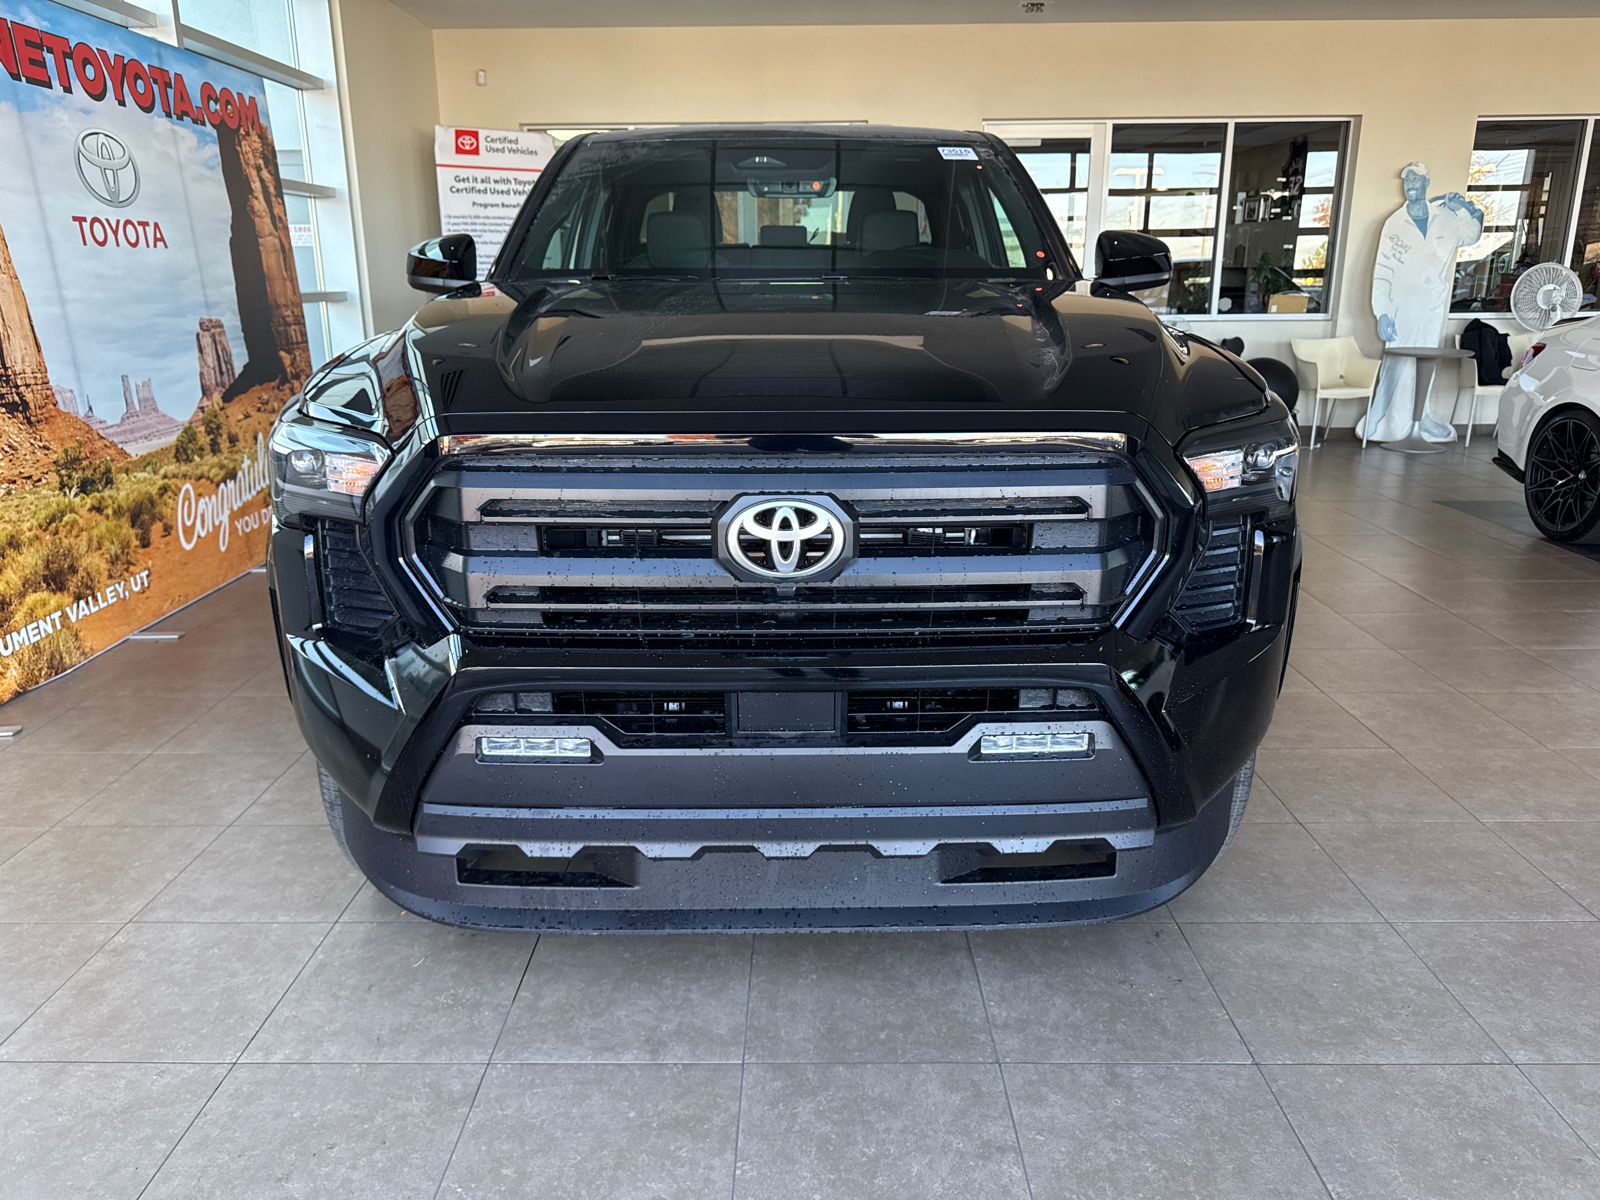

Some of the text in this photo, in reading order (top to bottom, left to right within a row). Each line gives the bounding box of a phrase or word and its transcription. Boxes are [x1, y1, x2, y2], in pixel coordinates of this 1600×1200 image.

[484, 135, 519, 145] Certified
[485, 145, 538, 156] Used Vehicles
[454, 175, 471, 184] Get
[472, 175, 479, 184] it
[480, 176, 492, 185] all
[493, 177, 512, 186] with
[449, 185, 488, 195] Certified
[489, 187, 511, 196] Used
[472, 201, 500, 210] Program
[72, 215, 168, 249] TOYOTA
[234, 511, 259, 536] YOU
[65, 580, 129, 623] VALLEY,
[129, 569, 149, 592] UT
